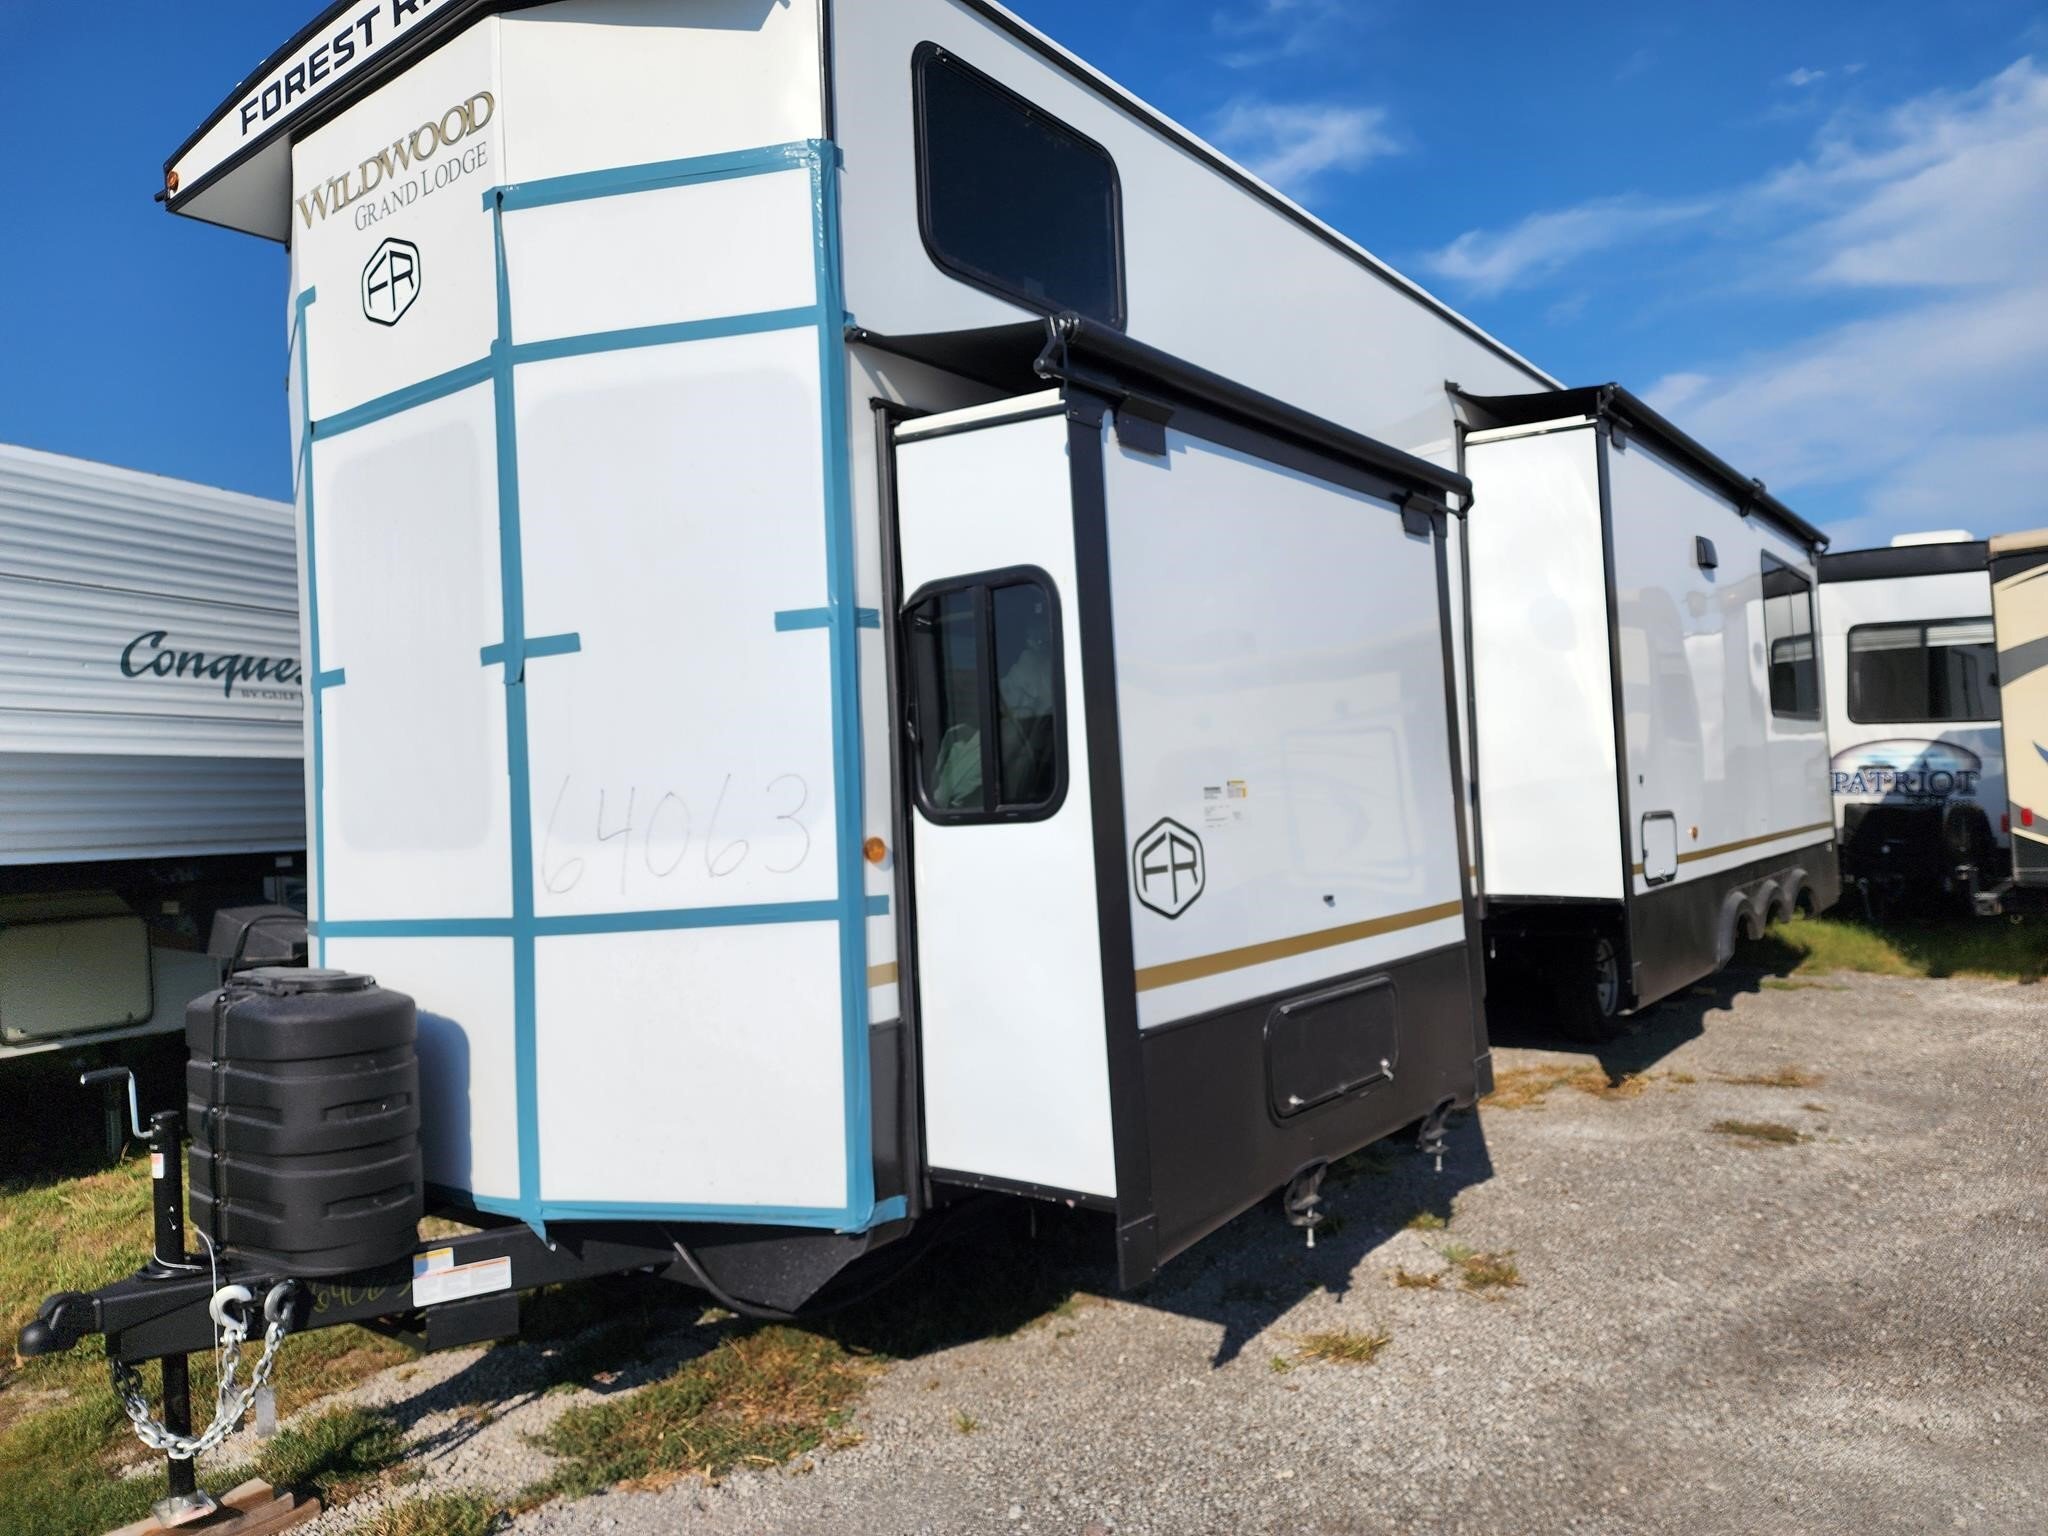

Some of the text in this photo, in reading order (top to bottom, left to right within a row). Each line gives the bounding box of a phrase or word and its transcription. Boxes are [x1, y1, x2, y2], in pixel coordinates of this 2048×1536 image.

[239, 4, 381, 136] FOREST
[295, 90, 495, 230] WILDWOOD
[354, 141, 488, 232] GRAND LODGE
[541, 773, 810, 895] 64063
[1831, 770, 1981, 797] PATRIOT
